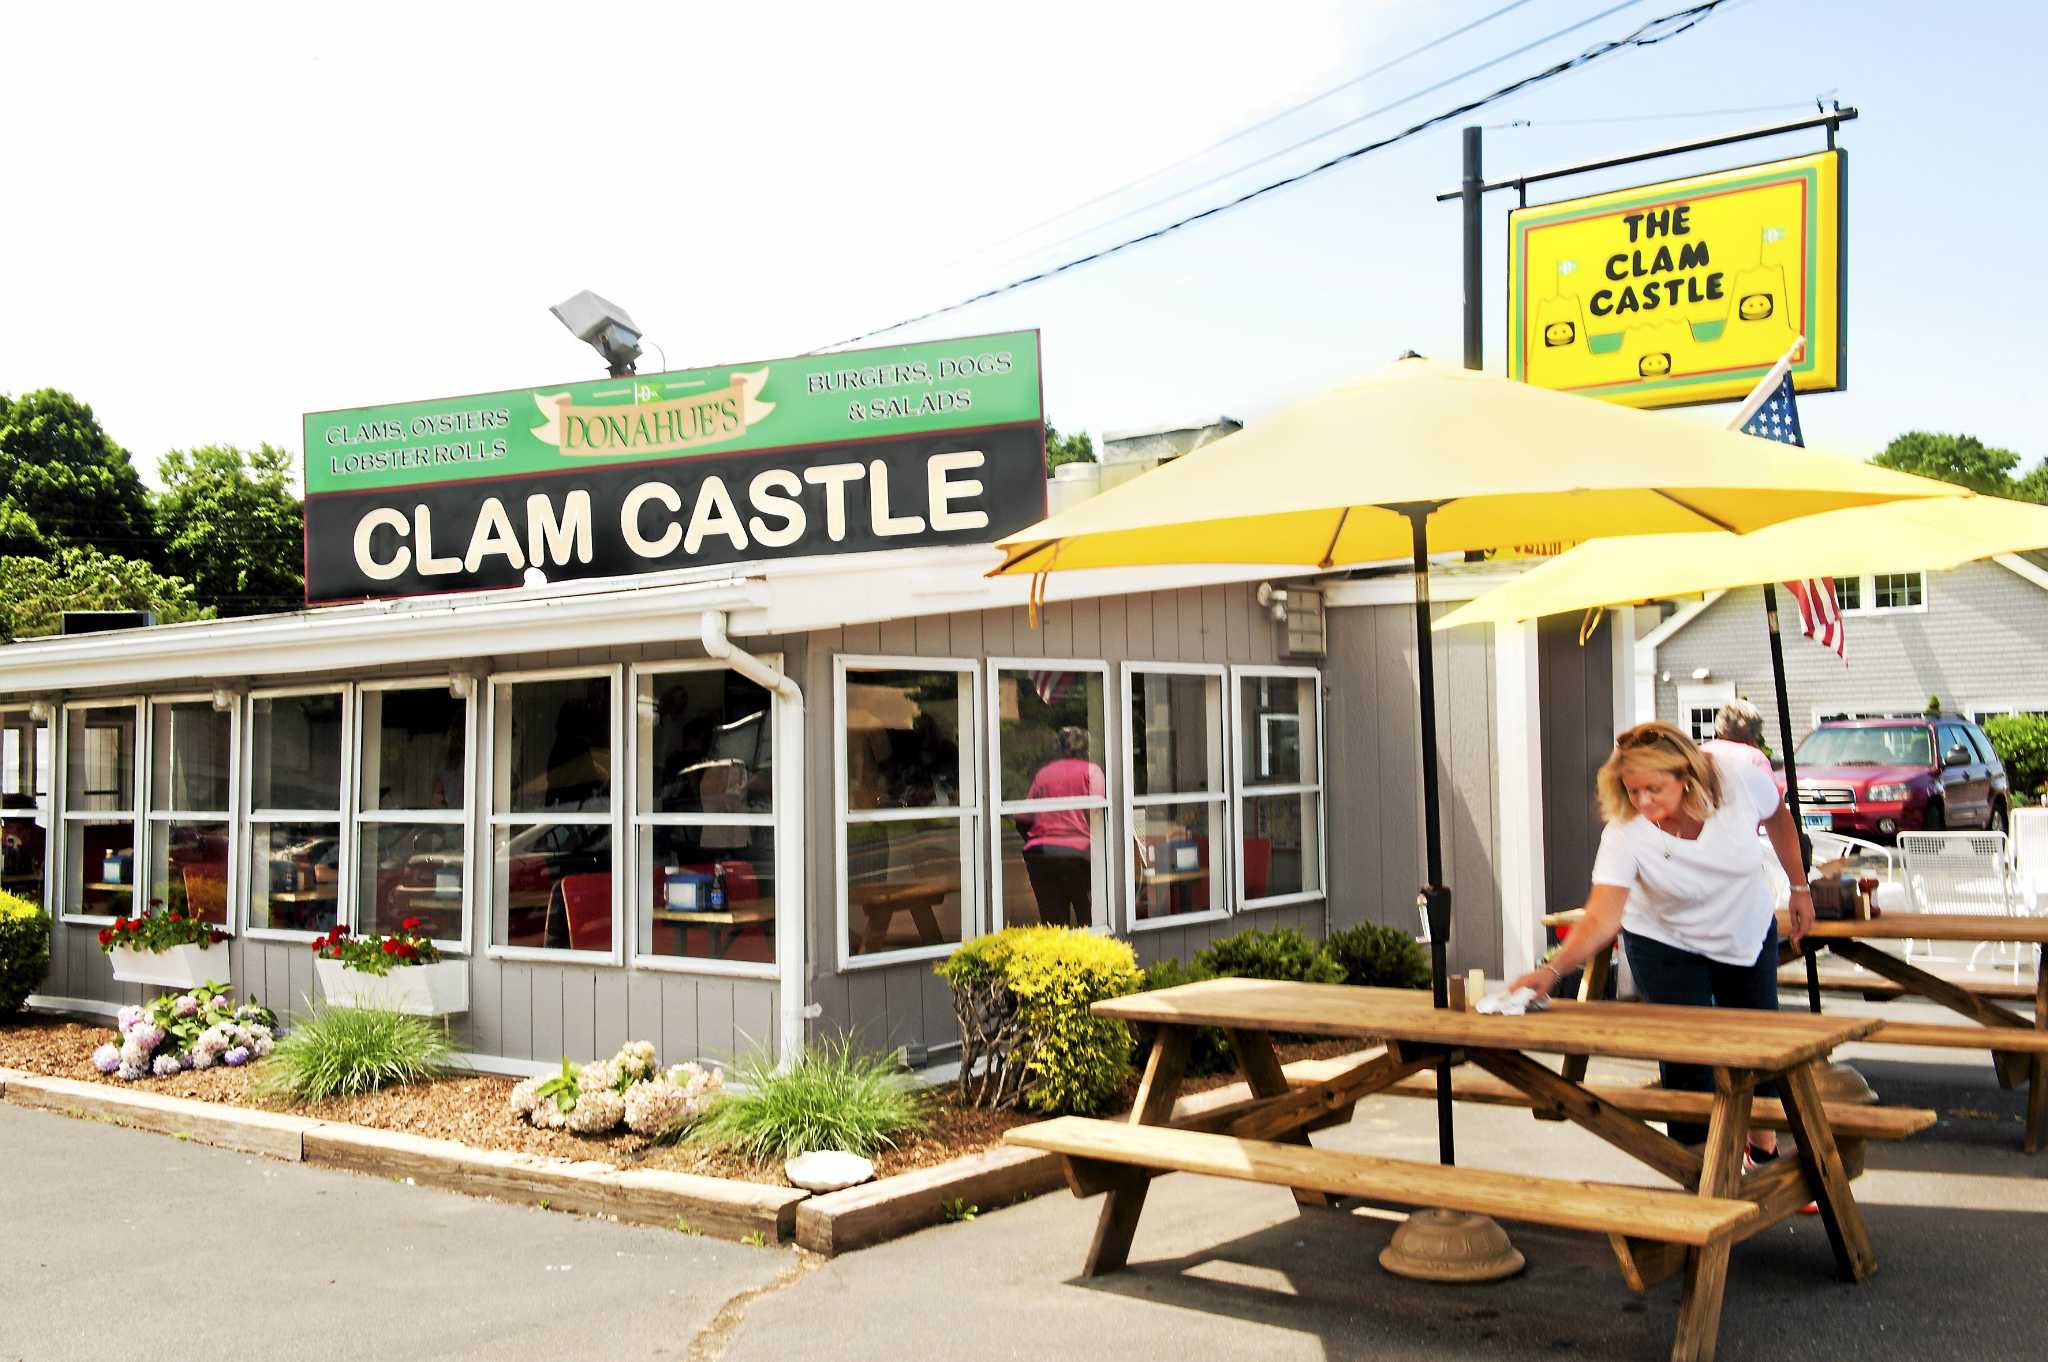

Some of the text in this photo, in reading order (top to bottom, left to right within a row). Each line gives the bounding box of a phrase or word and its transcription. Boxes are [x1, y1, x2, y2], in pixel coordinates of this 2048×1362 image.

[1623, 206, 1690, 243] THE
[1605, 241, 1710, 281] CLAM
[1590, 272, 1724, 317] CASTLE
[807, 352, 1012, 394] BURGERS, DOGS
[566, 399, 738, 449] DONAHUE'S
[848, 389, 970, 422] & SALADS
[326, 408, 510, 446] CLAMS, OYSTERS
[330, 439, 507, 475] LOBSTER ROLLS
[353, 450, 990, 581] CLAM CASTLE
